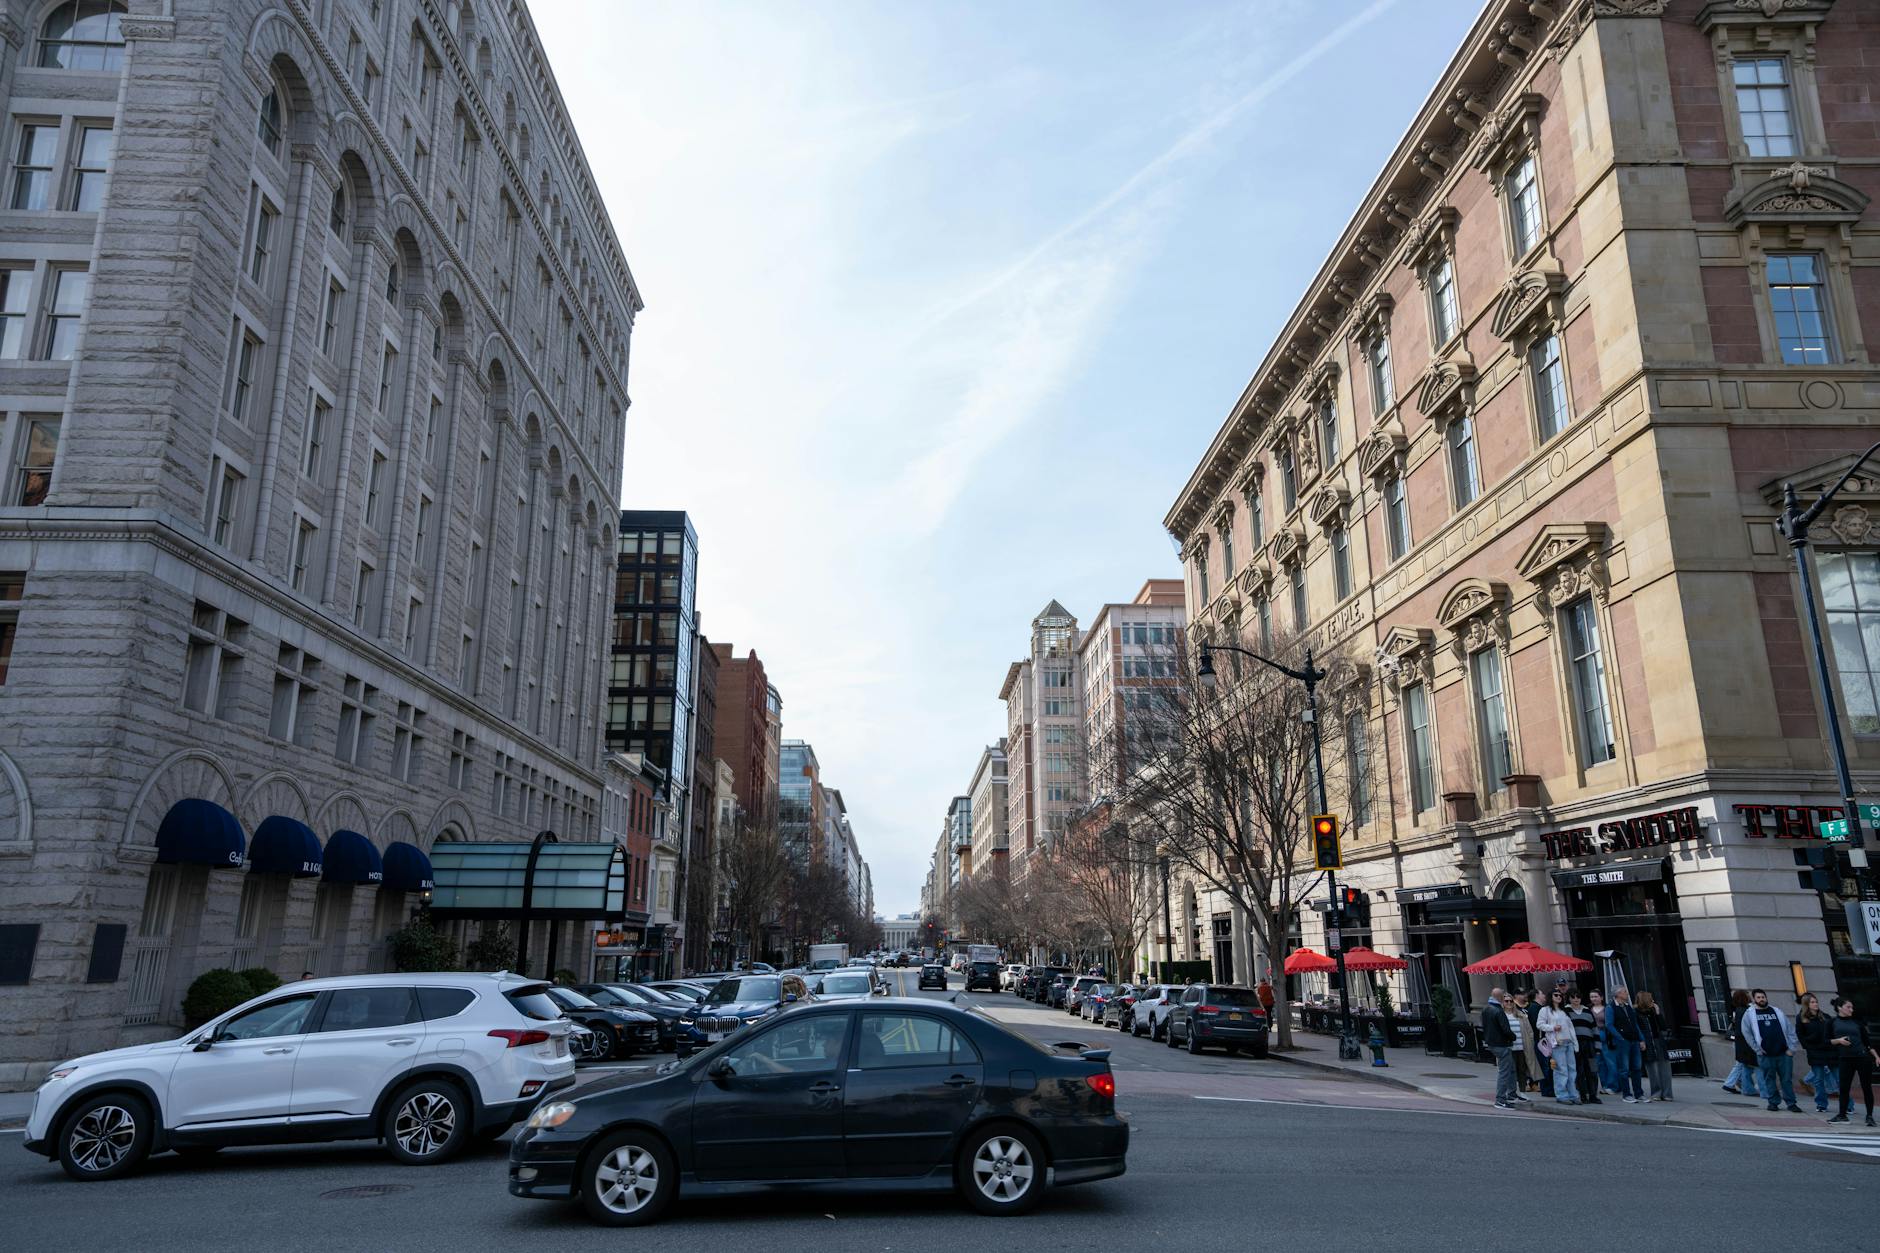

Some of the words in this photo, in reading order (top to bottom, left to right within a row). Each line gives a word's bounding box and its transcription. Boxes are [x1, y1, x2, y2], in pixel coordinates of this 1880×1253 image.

[1540, 827, 1595, 860] THE
[1598, 806, 1703, 854] SMITH
[1828, 823, 1835, 835] F
[1581, 873, 1598, 884] THE
[1598, 870, 1624, 882] SMITH
